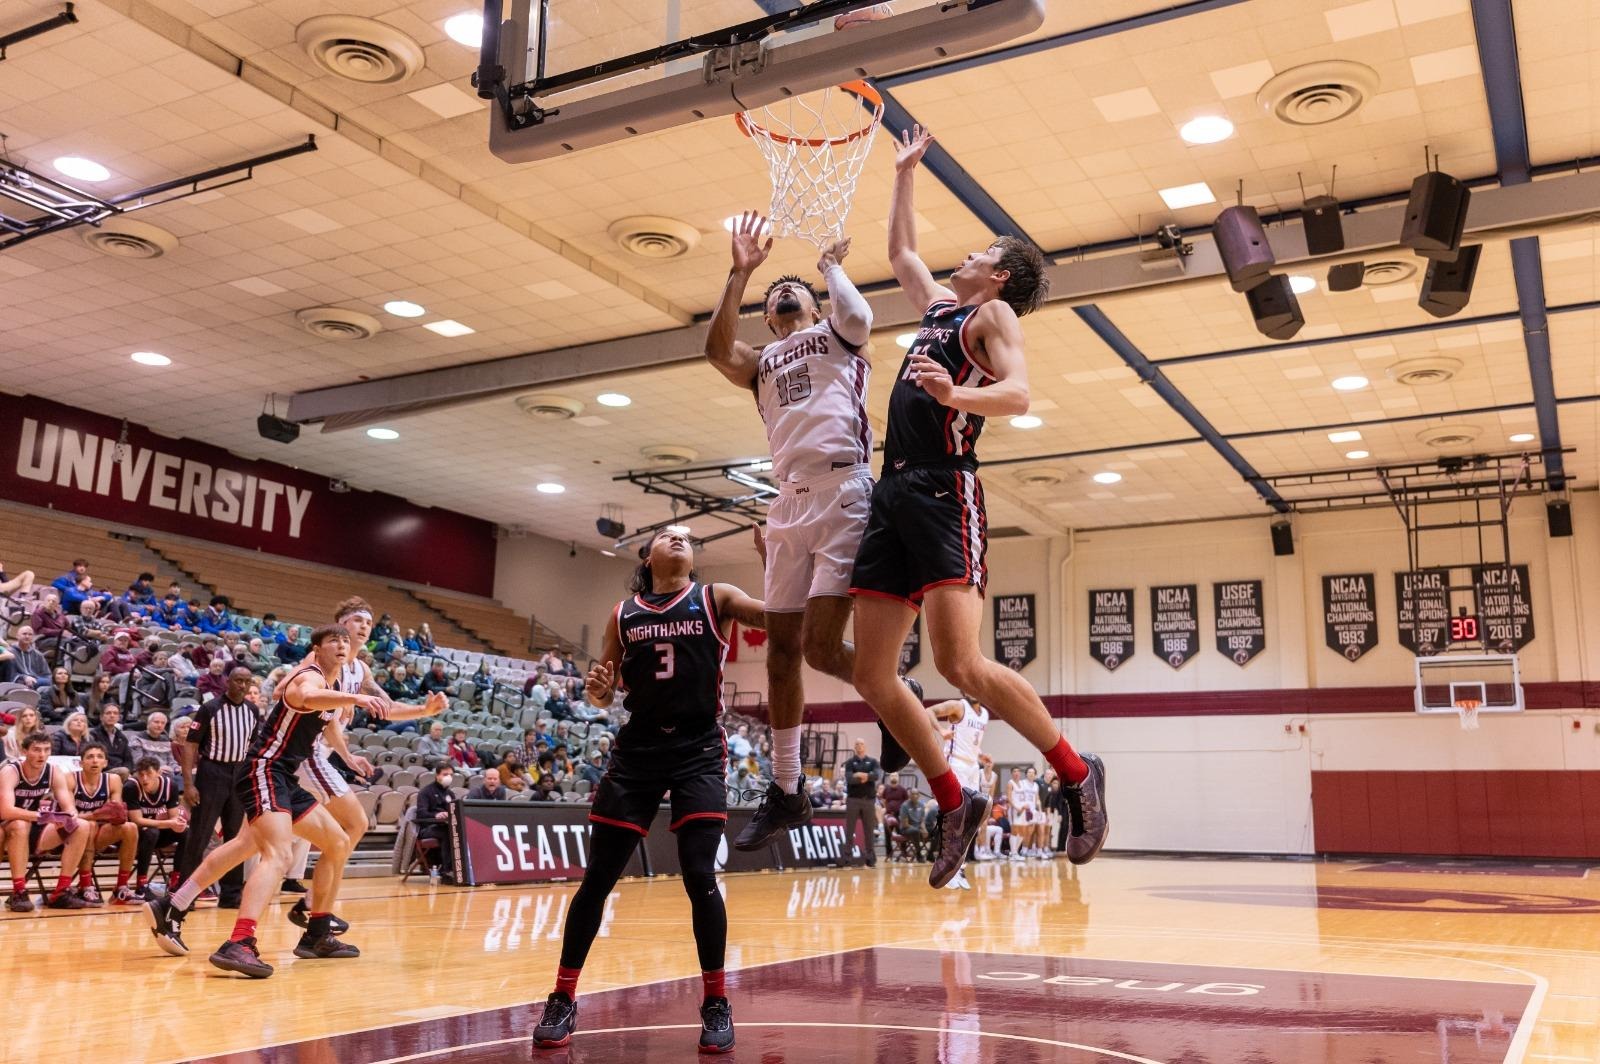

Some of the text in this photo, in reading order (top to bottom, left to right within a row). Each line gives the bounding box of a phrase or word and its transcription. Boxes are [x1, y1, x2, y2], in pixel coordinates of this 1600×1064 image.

[775, 362, 812, 407] 15
[16, 416, 312, 538] UNIVERSITY
[795, 486, 810, 495] SPU
[1483, 569, 1520, 585] NCAA
[1222, 585, 1254, 600] USGF
[1331, 577, 1367, 594] NCAA
[1096, 592, 1127, 607] NCAA
[1158, 588, 1190, 604] NCAA
[1000, 598, 1029, 612] NCAA
[1331, 602, 1369, 612] NATIONAL
[1404, 599, 1444, 610] NAIONAL
[1095, 615, 1128, 624] NATIONAL
[1158, 612, 1191, 621] NATIONAL
[1222, 608, 1256, 618] NATIONAL
[1327, 611, 1374, 623] CHAMPIONS
[999, 621, 1030, 630] NATIONAL
[1092, 624, 1132, 634] CHAMPIONS
[1154, 620, 1196, 632] CHAMPIONS
[1218, 617, 1261, 628] CHAMPIONS
[1452, 618, 1477, 639] 30
[626, 620, 703, 643] NIGHTHAWKS
[996, 628, 1034, 640] CHAMPIONS
[1339, 630, 1365, 645] 1993
[1490, 624, 1522, 640] 2008
[1101, 641, 1123, 654] 1986
[1164, 638, 1188, 652] 1986
[1228, 635, 1253, 649] 1992
[1005, 645, 1026, 658] 1985
[655, 643, 674, 679] 3
[491, 824, 593, 872] SEATT
